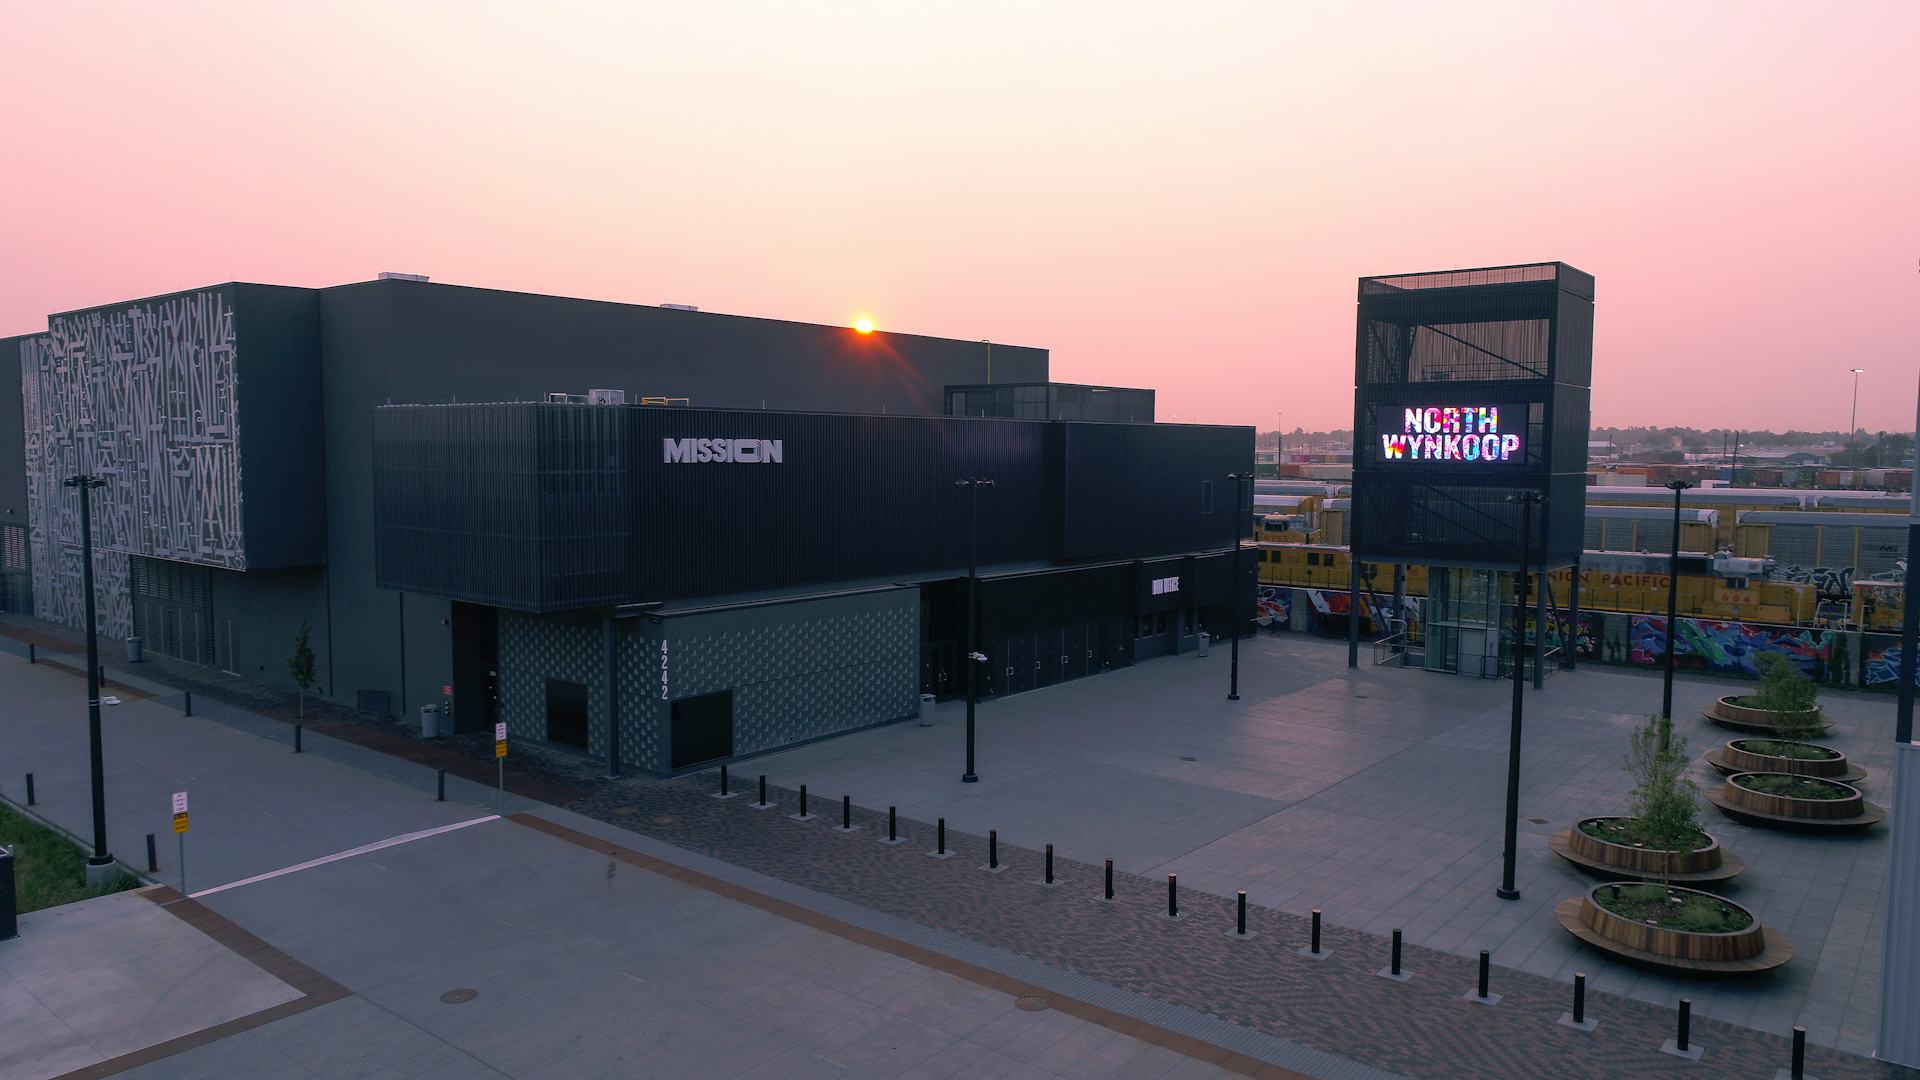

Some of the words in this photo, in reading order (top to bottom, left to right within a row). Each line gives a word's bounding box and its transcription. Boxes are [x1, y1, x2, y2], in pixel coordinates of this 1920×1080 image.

[1404, 407, 1498, 433] NORTH
[663, 438, 783, 463] MISSION
[1382, 433, 1520, 461] WYNKOOP
[1601, 573, 1671, 588] PACIFIC
[661, 639, 669, 700] 4242
